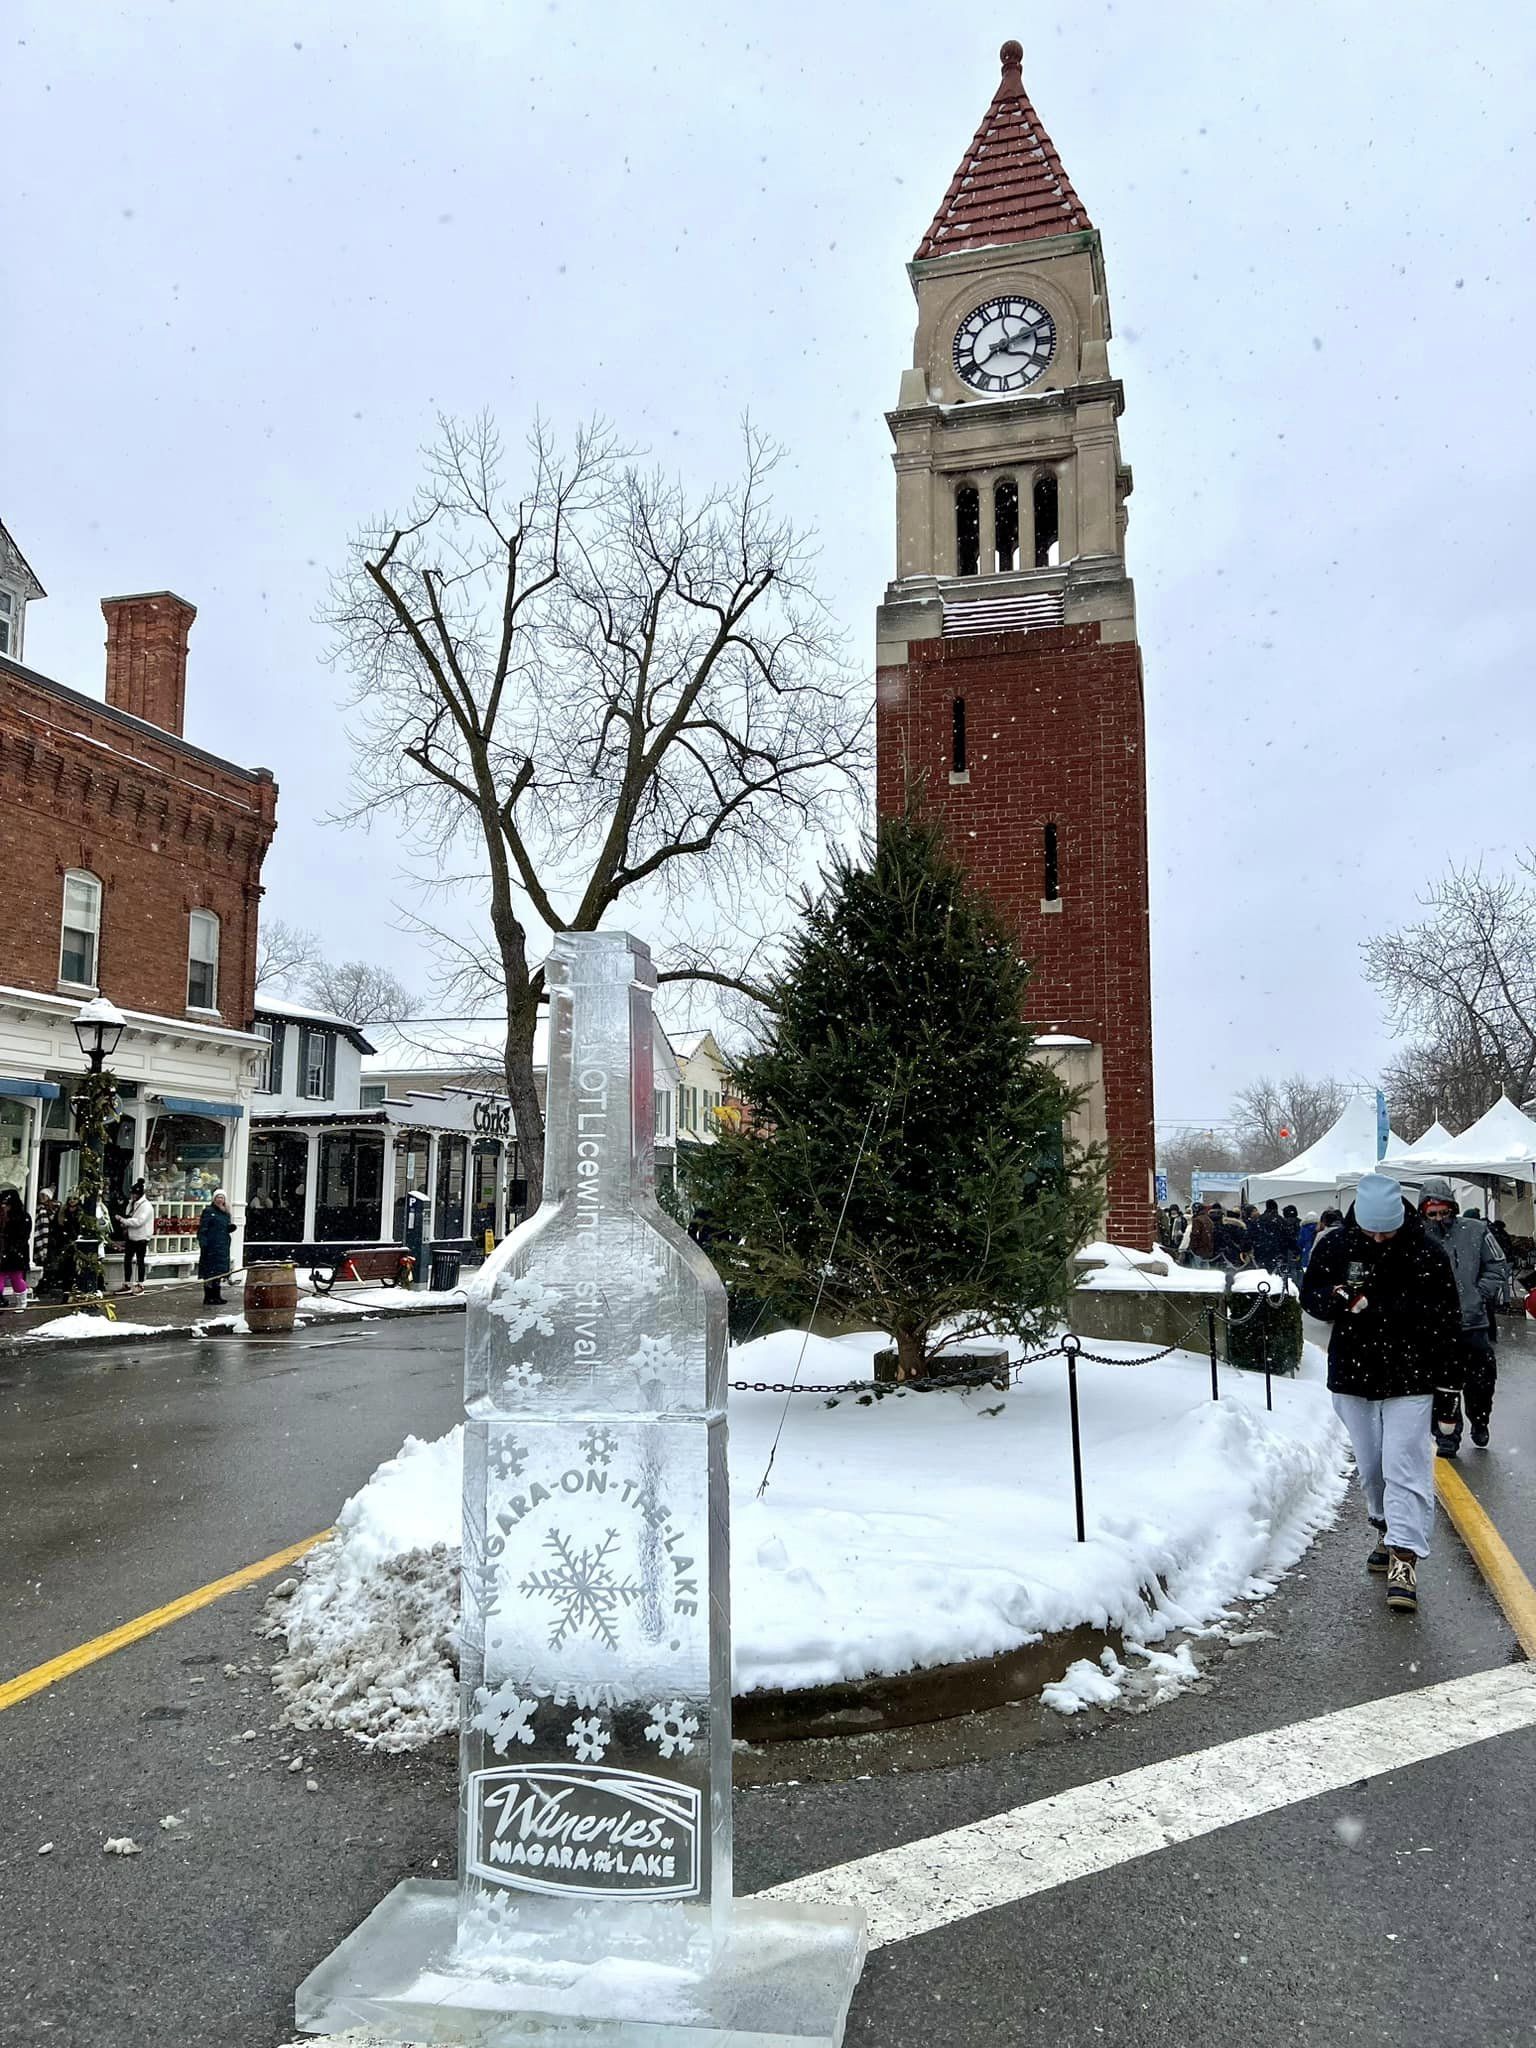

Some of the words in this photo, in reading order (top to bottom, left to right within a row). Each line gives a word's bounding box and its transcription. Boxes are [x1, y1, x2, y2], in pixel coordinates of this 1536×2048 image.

[473, 1102, 511, 1134] Corks
[409, 1197, 417, 1207] P
[522, 1664, 650, 1710] ICEWIN
[484, 1783, 666, 1849] Wineries
